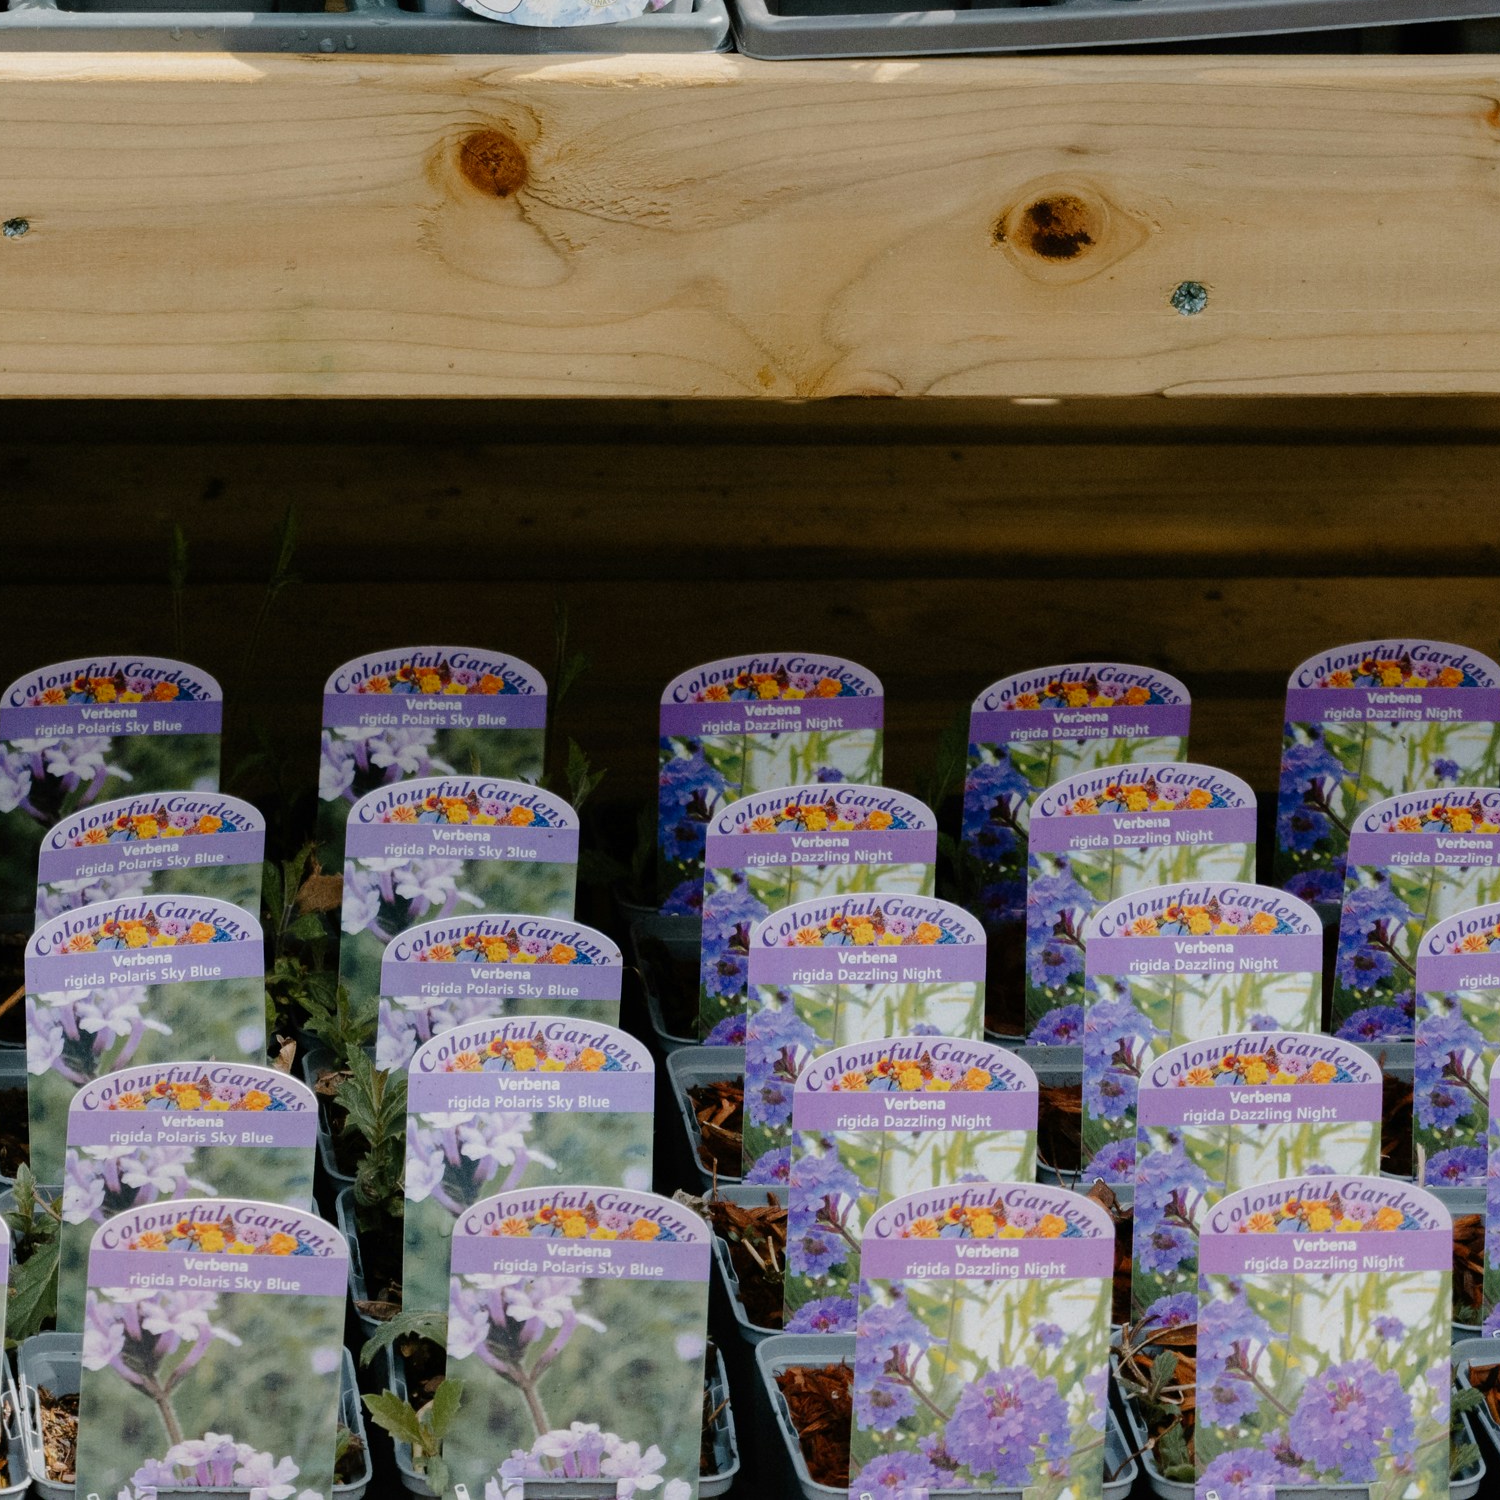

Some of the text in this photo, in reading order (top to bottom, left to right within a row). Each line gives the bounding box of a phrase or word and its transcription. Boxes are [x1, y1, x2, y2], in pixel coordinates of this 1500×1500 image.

[874, 1188, 1102, 1239] Colourful Gardens
[955, 1244, 1020, 1259] Verbena
[906, 1262, 1066, 1279] rigida Dazzling Night
